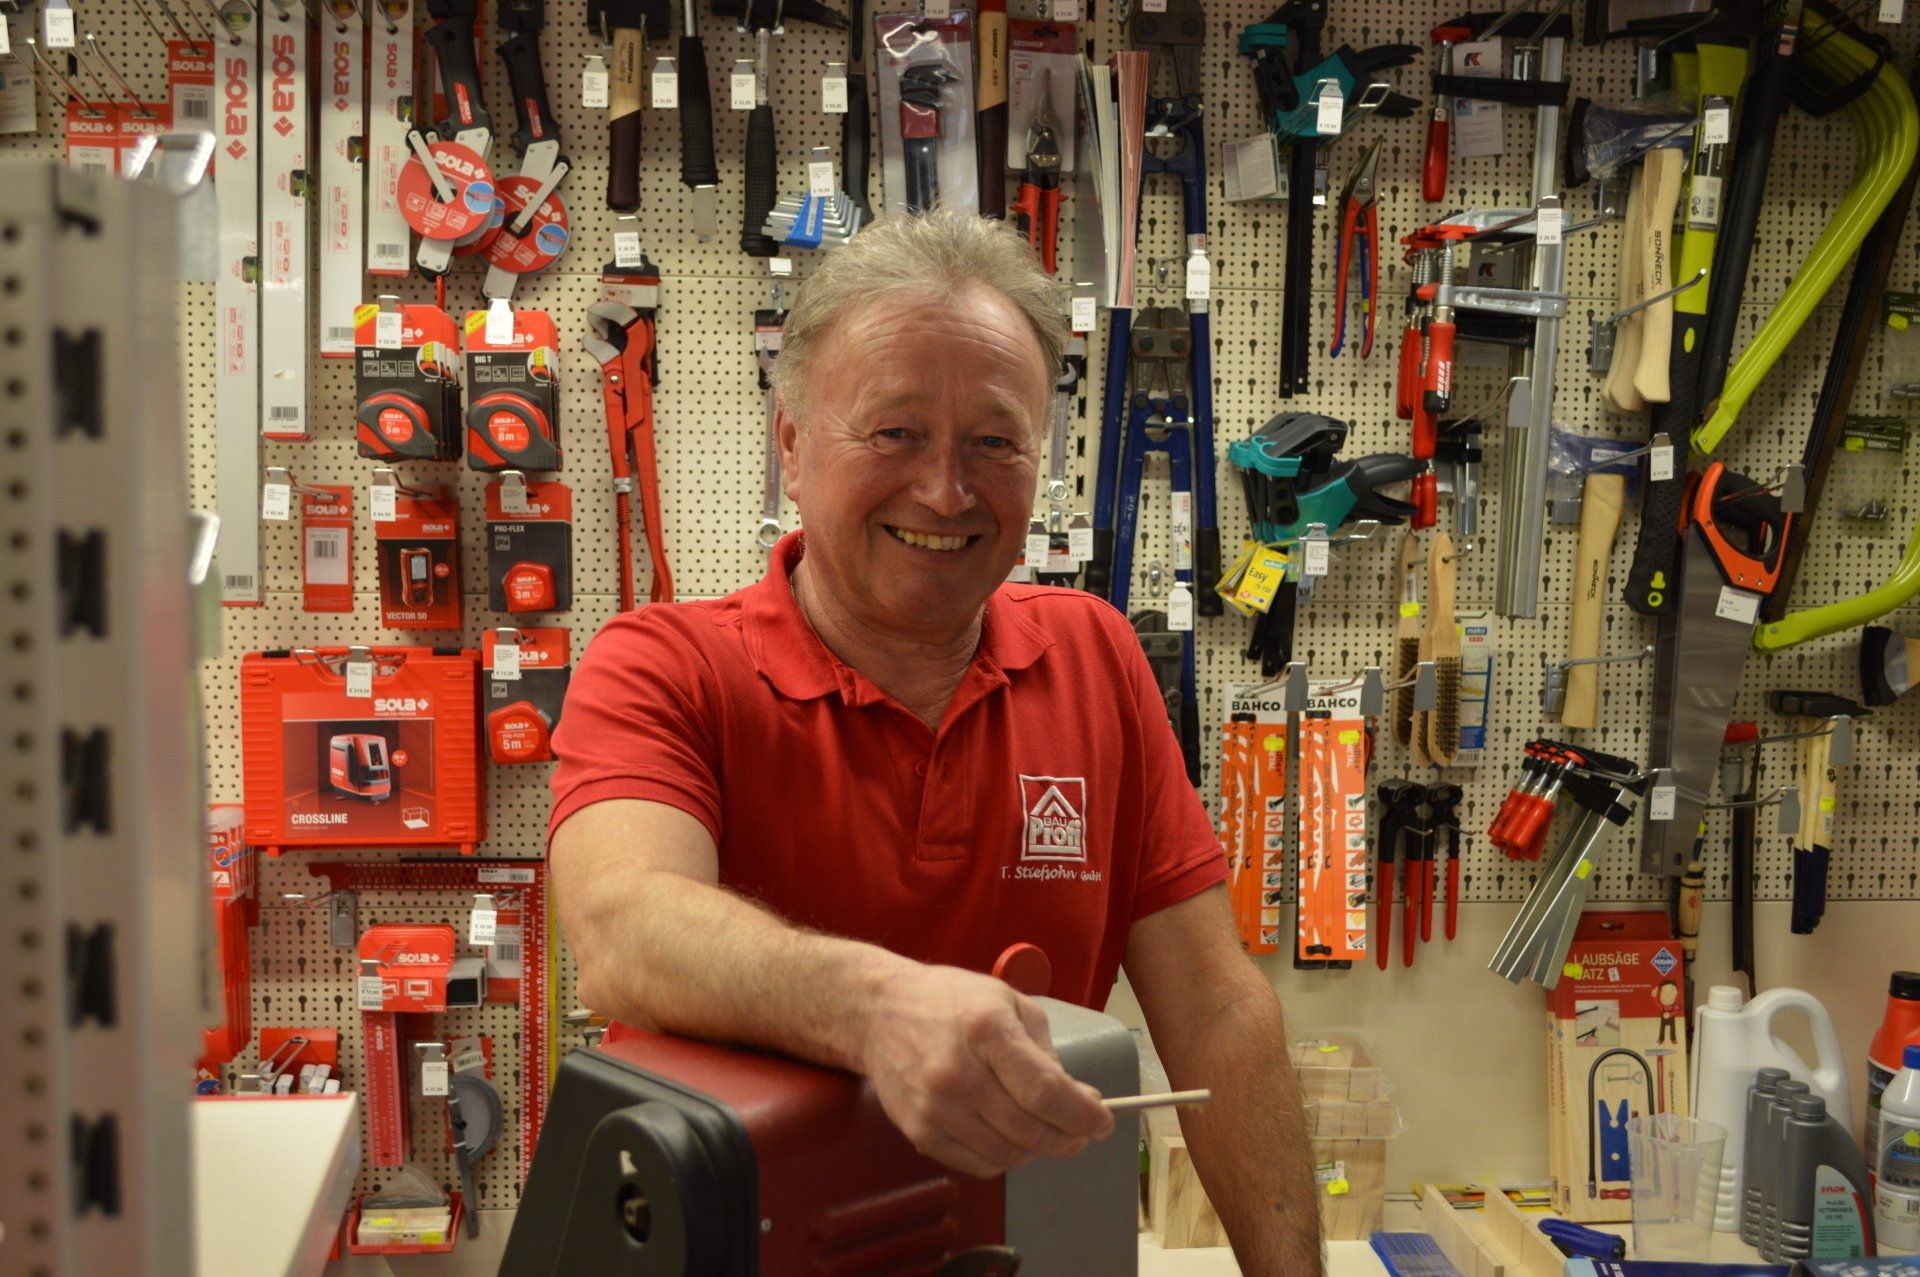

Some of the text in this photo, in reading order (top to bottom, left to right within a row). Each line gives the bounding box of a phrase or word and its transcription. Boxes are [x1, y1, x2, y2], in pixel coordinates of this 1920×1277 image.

[272, 34, 295, 112] SOLA
[333, 41, 350, 96] SOLA
[225, 58, 248, 136] SOLA
[514, 184, 553, 218] SOA
[494, 525, 525, 533] PRO-FLEX
[1249, 567, 1269, 583] Easy
[386, 612, 416, 620] VECTOR
[374, 698, 417, 712] SOLA
[1232, 701, 1281, 711] BAHCO
[1308, 698, 1357, 708] BAHCO
[291, 813, 348, 825] CROSSLINE
[1044, 816, 1067, 828] BAU
[1029, 815, 1081, 847] Profi
[1001, 866, 1011, 879] T.
[1015, 865, 1077, 881] Stiefsohn
[1574, 951, 1640, 966] LAUBSÄGE
[1579, 968, 1604, 980] ATZ
